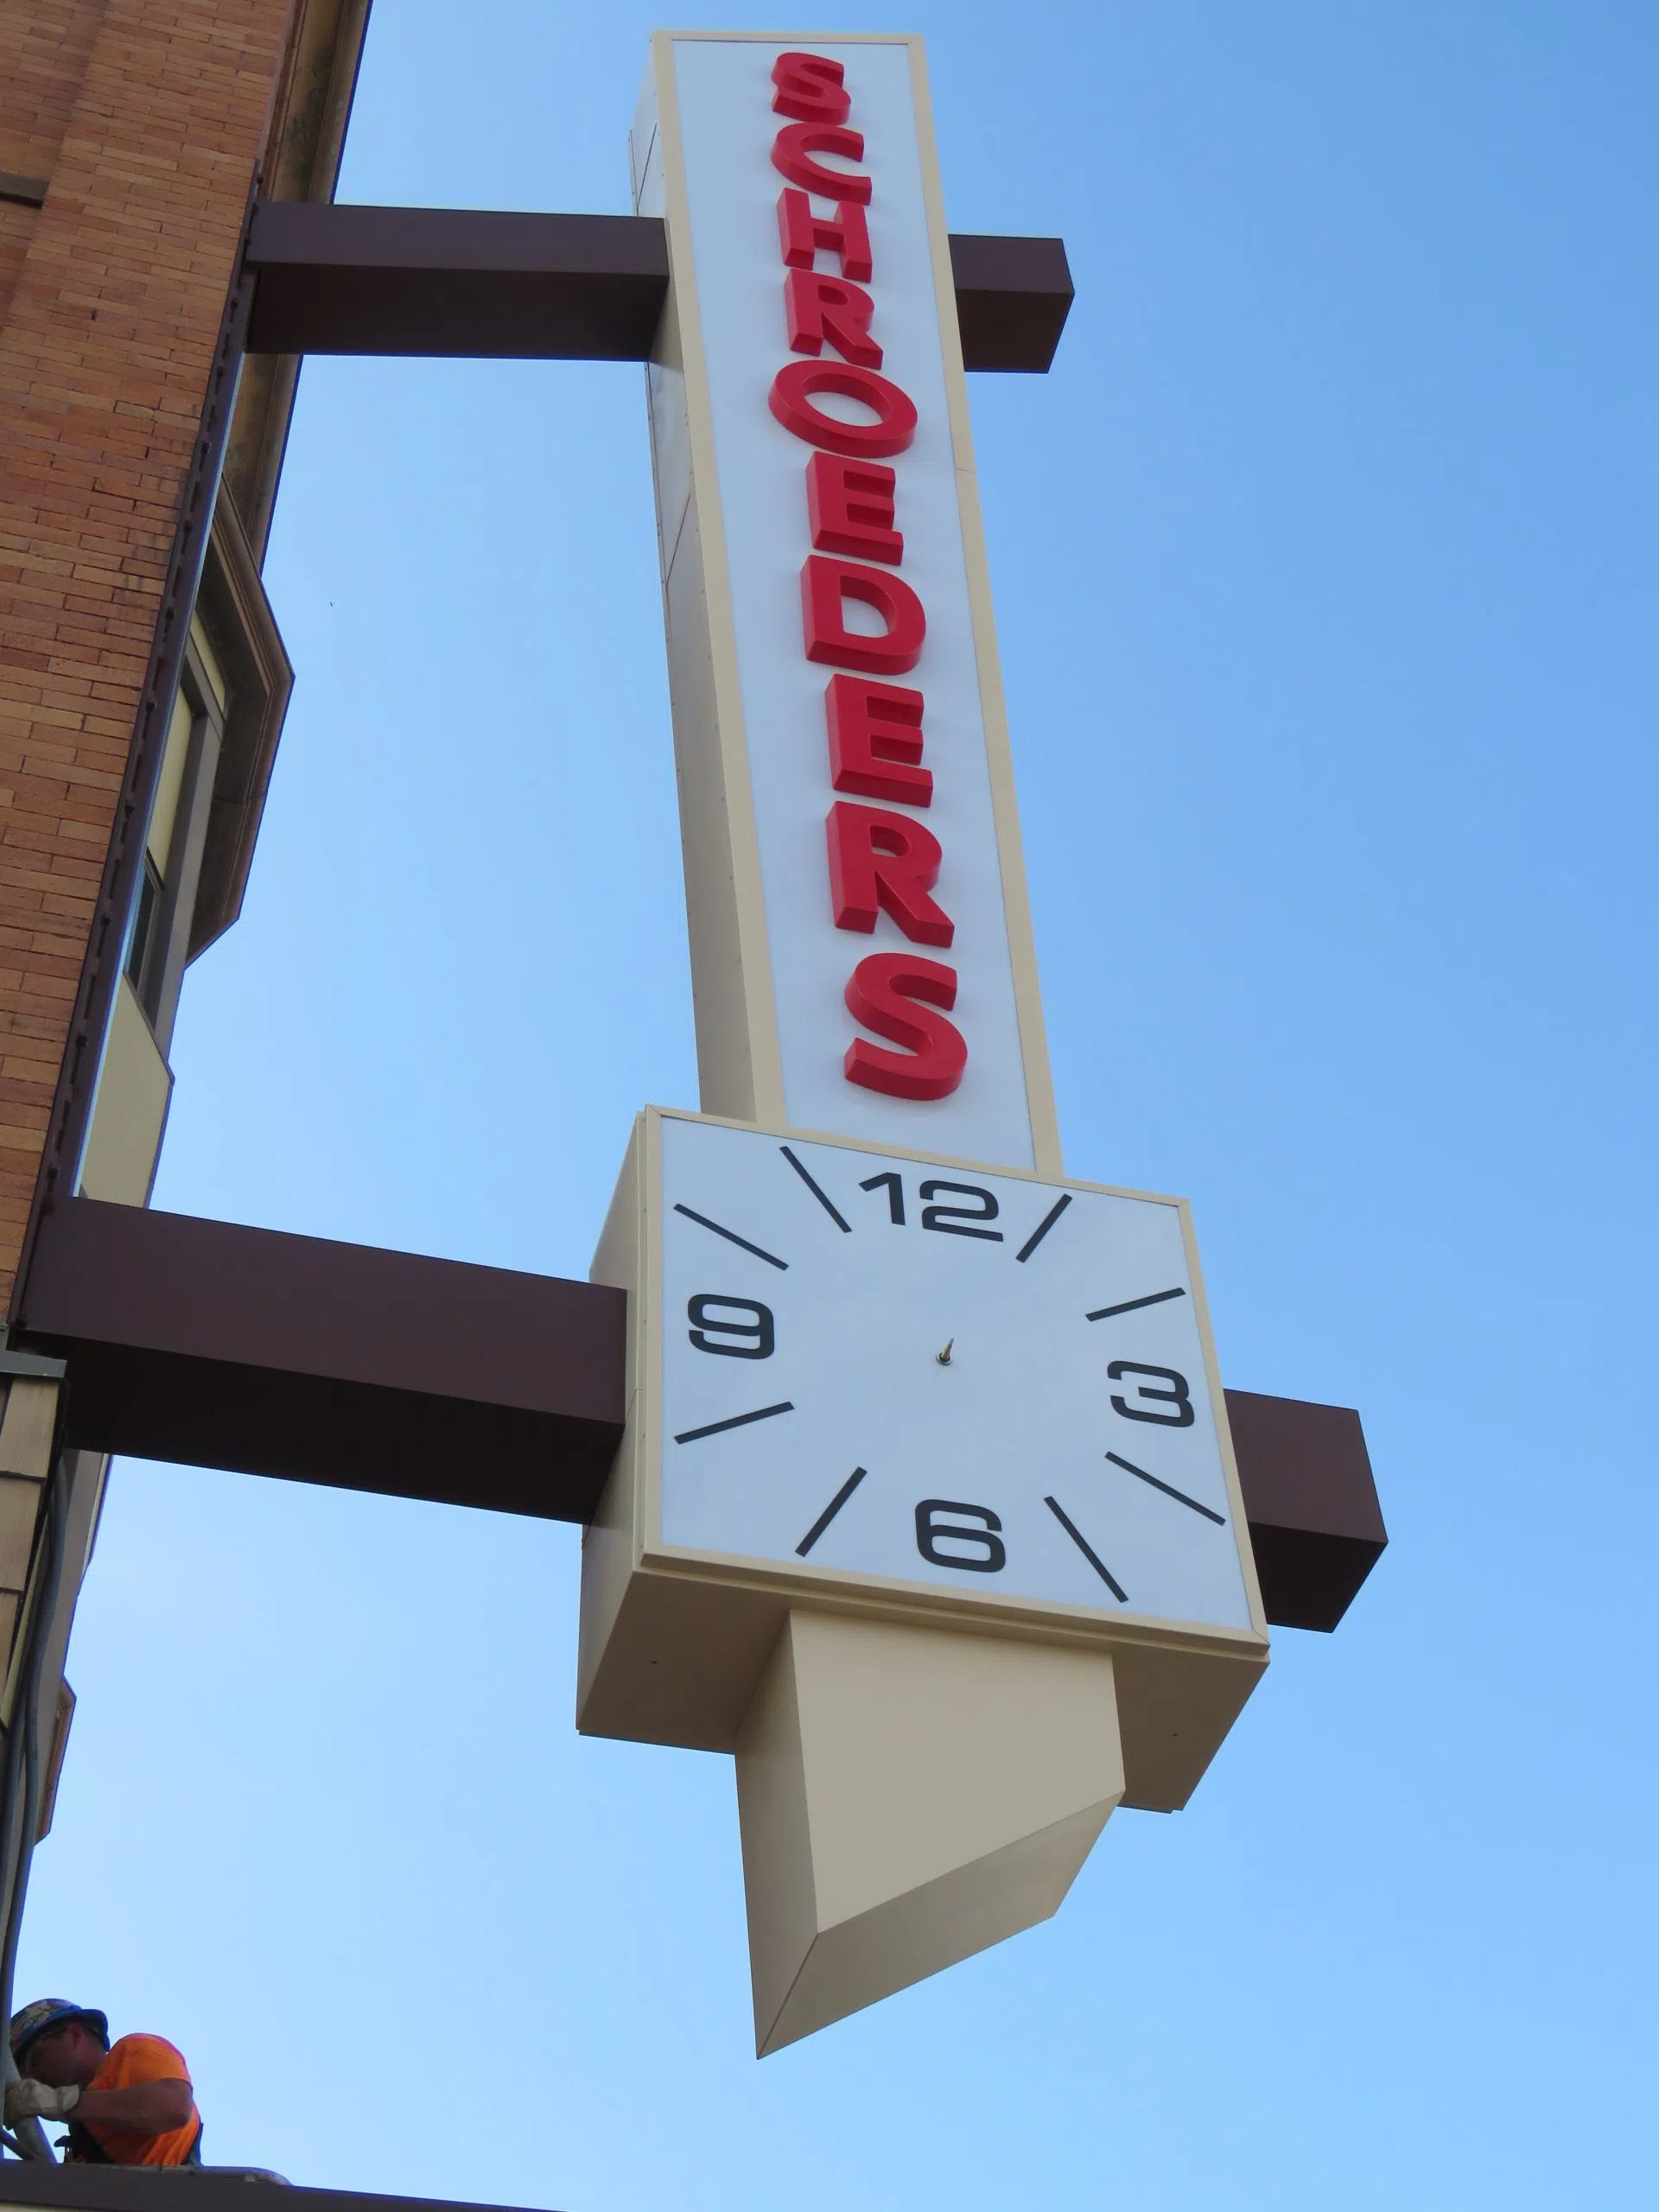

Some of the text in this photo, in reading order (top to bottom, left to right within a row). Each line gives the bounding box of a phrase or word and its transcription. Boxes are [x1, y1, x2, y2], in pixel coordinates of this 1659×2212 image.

[770, 53, 967, 1102] SCHROEDERS
[859, 1172, 1004, 1243] 12
[688, 1294, 775, 1360] 9
[1107, 1360, 1195, 1427] 3
[914, 1499, 1006, 1573] 6
